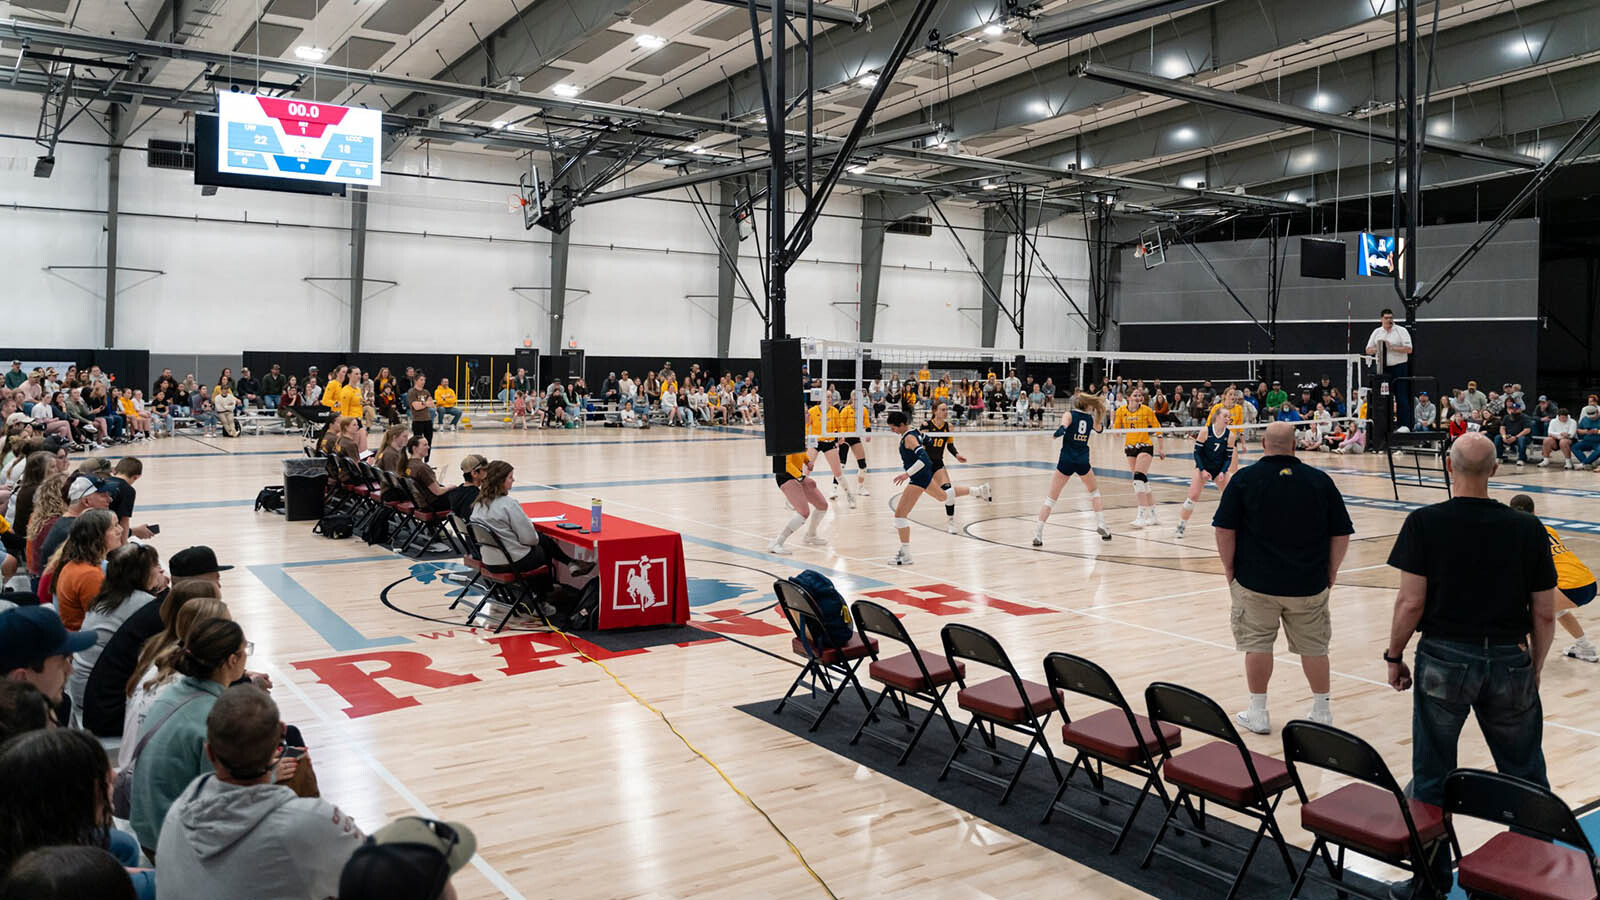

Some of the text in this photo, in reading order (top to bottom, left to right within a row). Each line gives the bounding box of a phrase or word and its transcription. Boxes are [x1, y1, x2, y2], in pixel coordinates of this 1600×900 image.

[288, 103, 319, 118] 00.0
[254, 135, 268, 145] 22
[1078, 420, 1087, 434] 8
[933, 438, 944, 447] 10
[1214, 442, 1220, 451] 7
